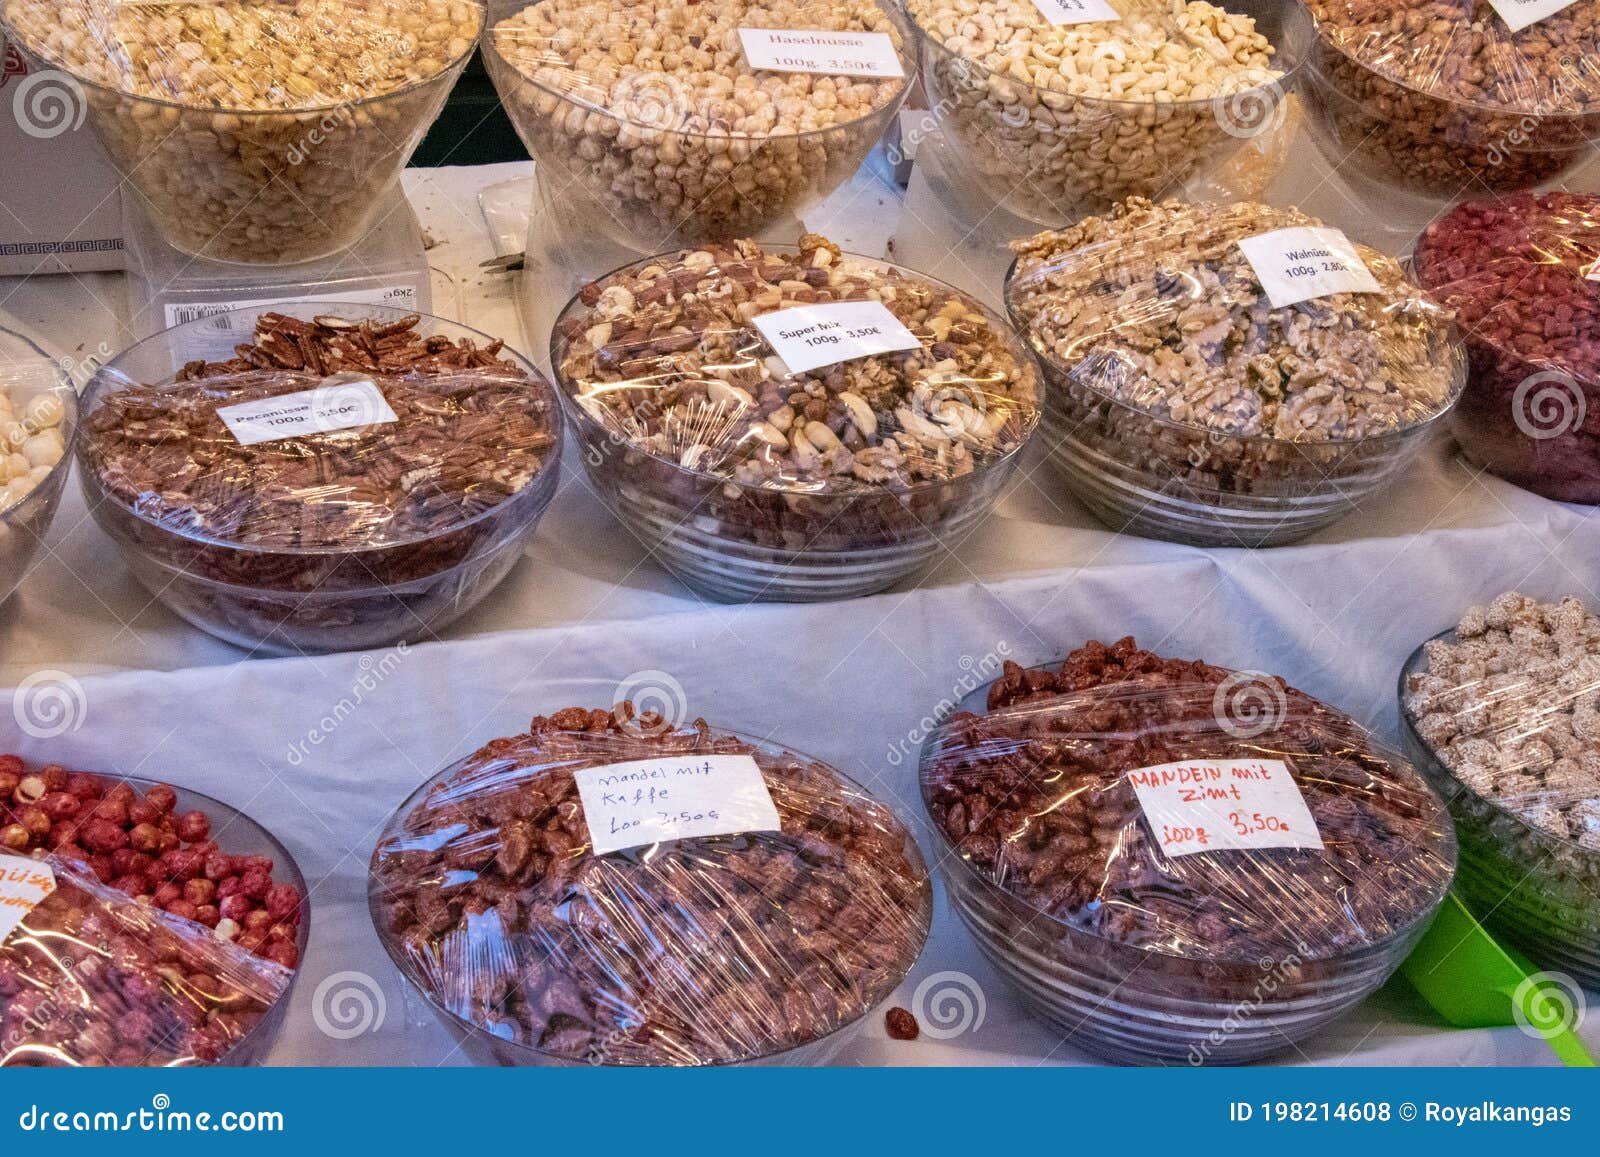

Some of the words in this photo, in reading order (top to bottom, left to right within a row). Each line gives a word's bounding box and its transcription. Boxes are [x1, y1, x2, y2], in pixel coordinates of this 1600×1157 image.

[779, 326, 816, 340] Super
[817, 320, 842, 331] Mix
[846, 326, 882, 339] 3,50€
[316, 405, 359, 418] 3,50€
[1231, 764, 1272, 781] mit
[602, 787, 669, 806] Kaffe
